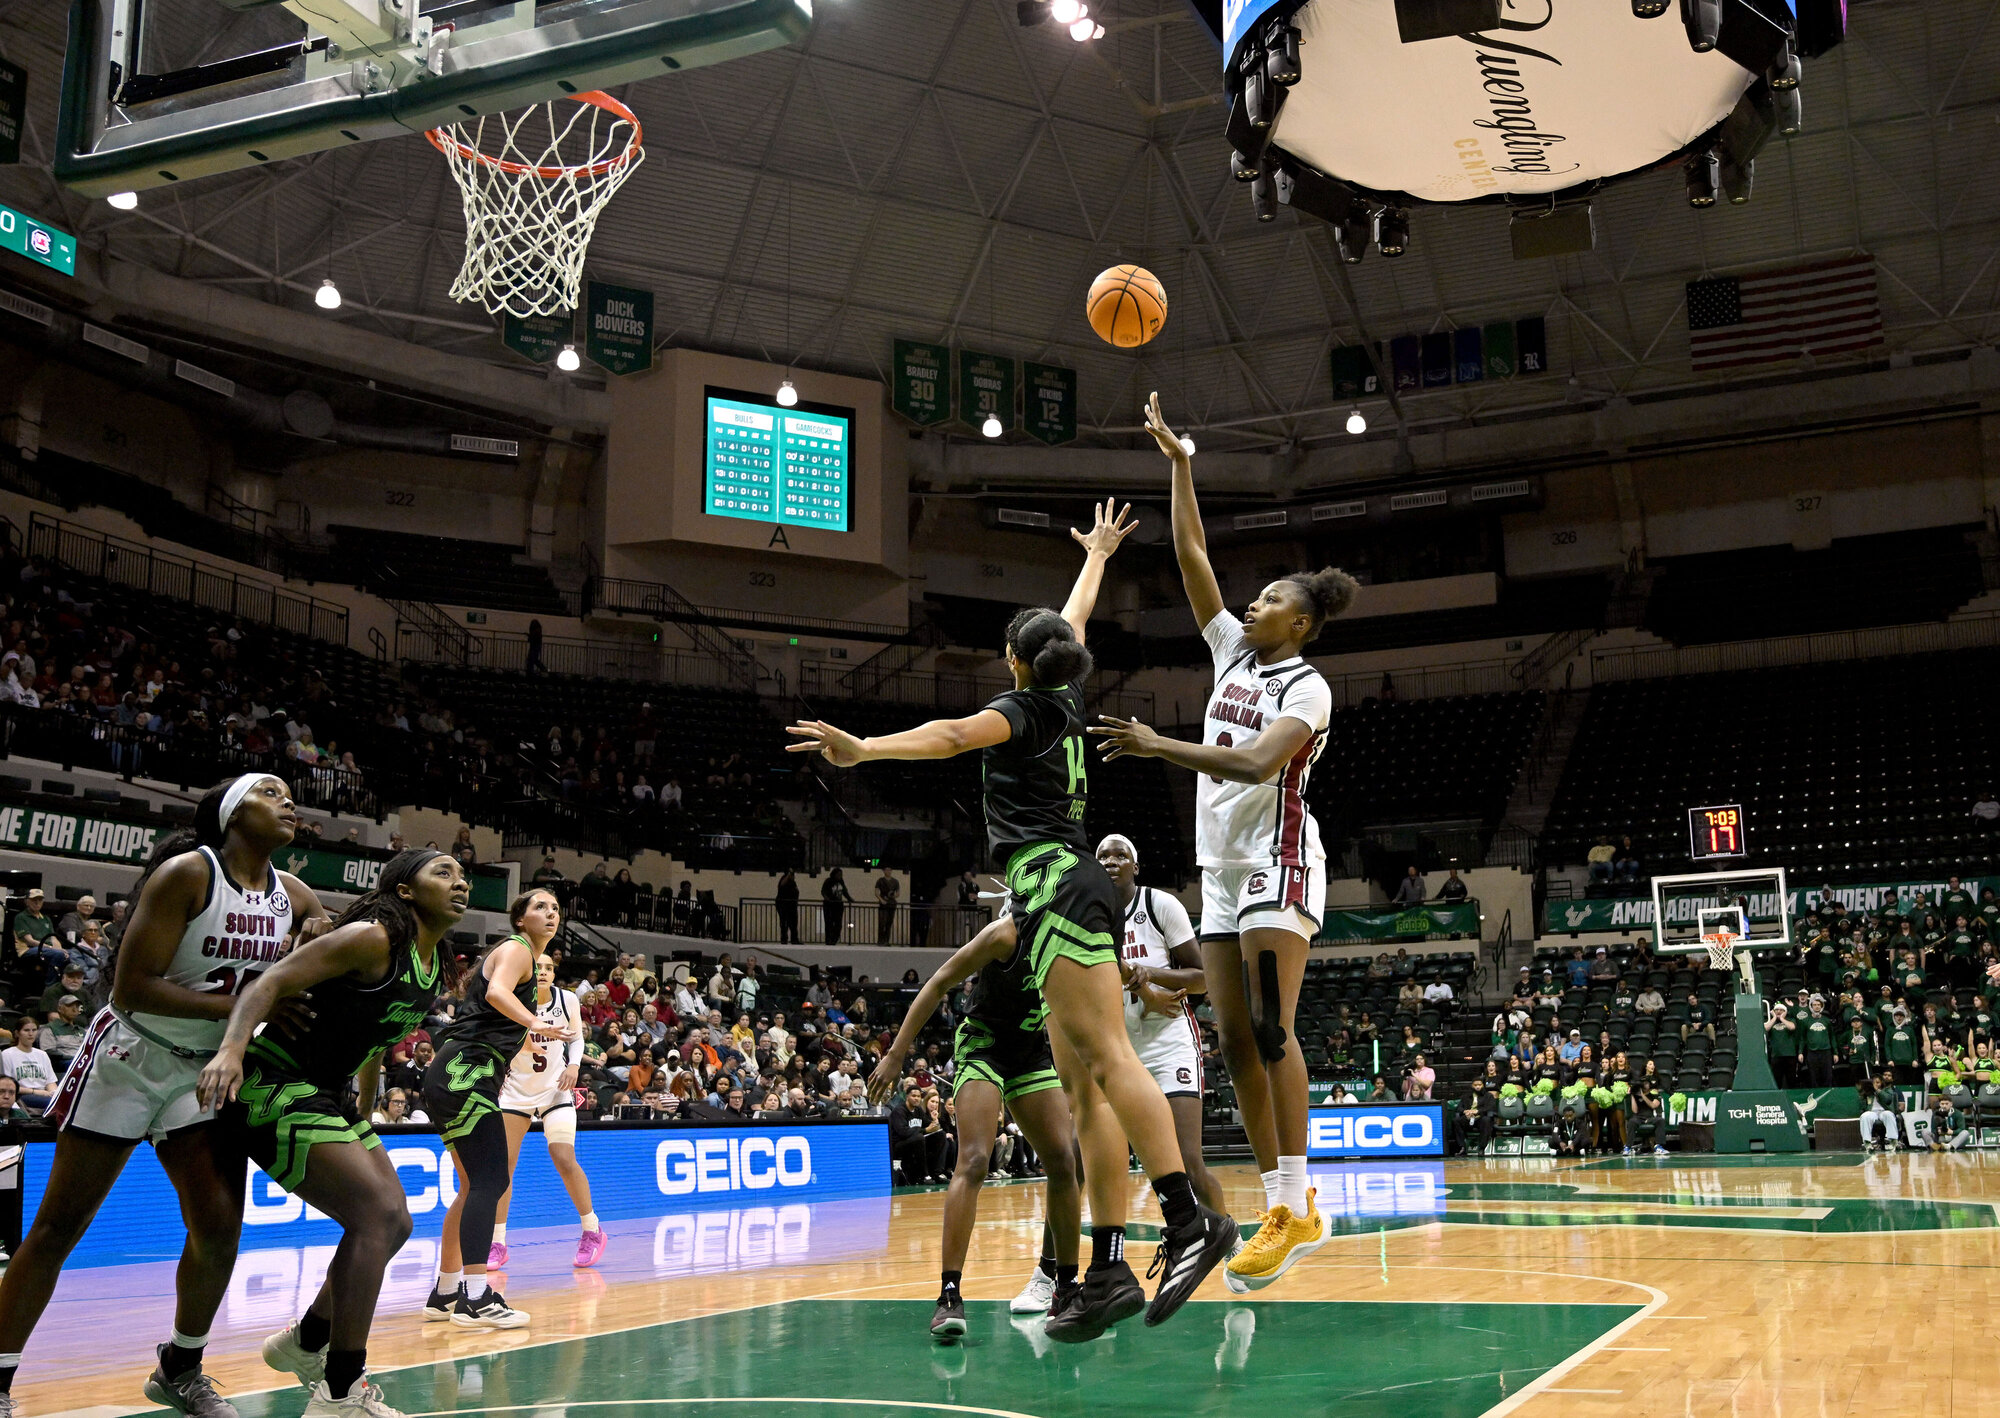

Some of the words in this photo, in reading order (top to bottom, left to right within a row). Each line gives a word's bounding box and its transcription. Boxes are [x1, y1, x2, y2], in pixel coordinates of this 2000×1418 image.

[607, 299, 635, 319] DICK
[595, 313, 645, 336] BOWERS
[906, 366, 938, 380] BRADLEY
[910, 380, 935, 402] 30
[978, 390, 997, 412] 31
[1042, 401, 1060, 422] 12
[734, 414, 754, 424] BULLS
[796, 422, 832, 436] GAMECOCKS
[752, 446, 759, 454] 0
[716, 454, 724, 462] 11
[799, 454, 805, 462] 2
[834, 459, 840, 467] 0
[740, 472, 747, 480] 0
[752, 474, 758, 482] 0
[799, 466, 805, 474] 2
[811, 468, 818, 476] 0
[834, 471, 840, 479] 0
[728, 486, 734, 494] 0
[751, 489, 758, 497] 0
[798, 481, 804, 489] 4
[811, 482, 818, 490] 2
[823, 484, 829, 492] 0
[385, 490, 415, 507] 322
[728, 500, 734, 508] 0
[740, 502, 746, 510] 0
[751, 503, 758, 511] 0
[786, 494, 795, 502] 11
[799, 495, 804, 503] 2
[834, 500, 840, 508] 0
[1796, 496, 1821, 512] 327
[798, 508, 804, 516] 0
[811, 510, 817, 518] 0
[768, 525, 790, 550] A
[1552, 531, 1577, 546] 326
[749, 571, 776, 588] 323
[1062, 736, 1087, 794] 14
[1705, 810, 1737, 826] 7:03
[27, 811, 77, 850] FOR
[79, 819, 157, 860] HOOPS
[1710, 826, 1736, 852] 17
[225, 912, 275, 937] SOUTH
[532, 1052, 548, 1073] 5
[1728, 1109, 1752, 1119] TGH
[1755, 1104, 1781, 1112] Tampa
[1755, 1110, 1785, 1118] General
[1756, 1116, 1788, 1125] Hospital
[1308, 1114, 1433, 1148] EICO
[1508, 1143, 1518, 1152] 98
[1539, 1142, 1549, 1152] 99
[656, 1136, 812, 1195] GEICO
